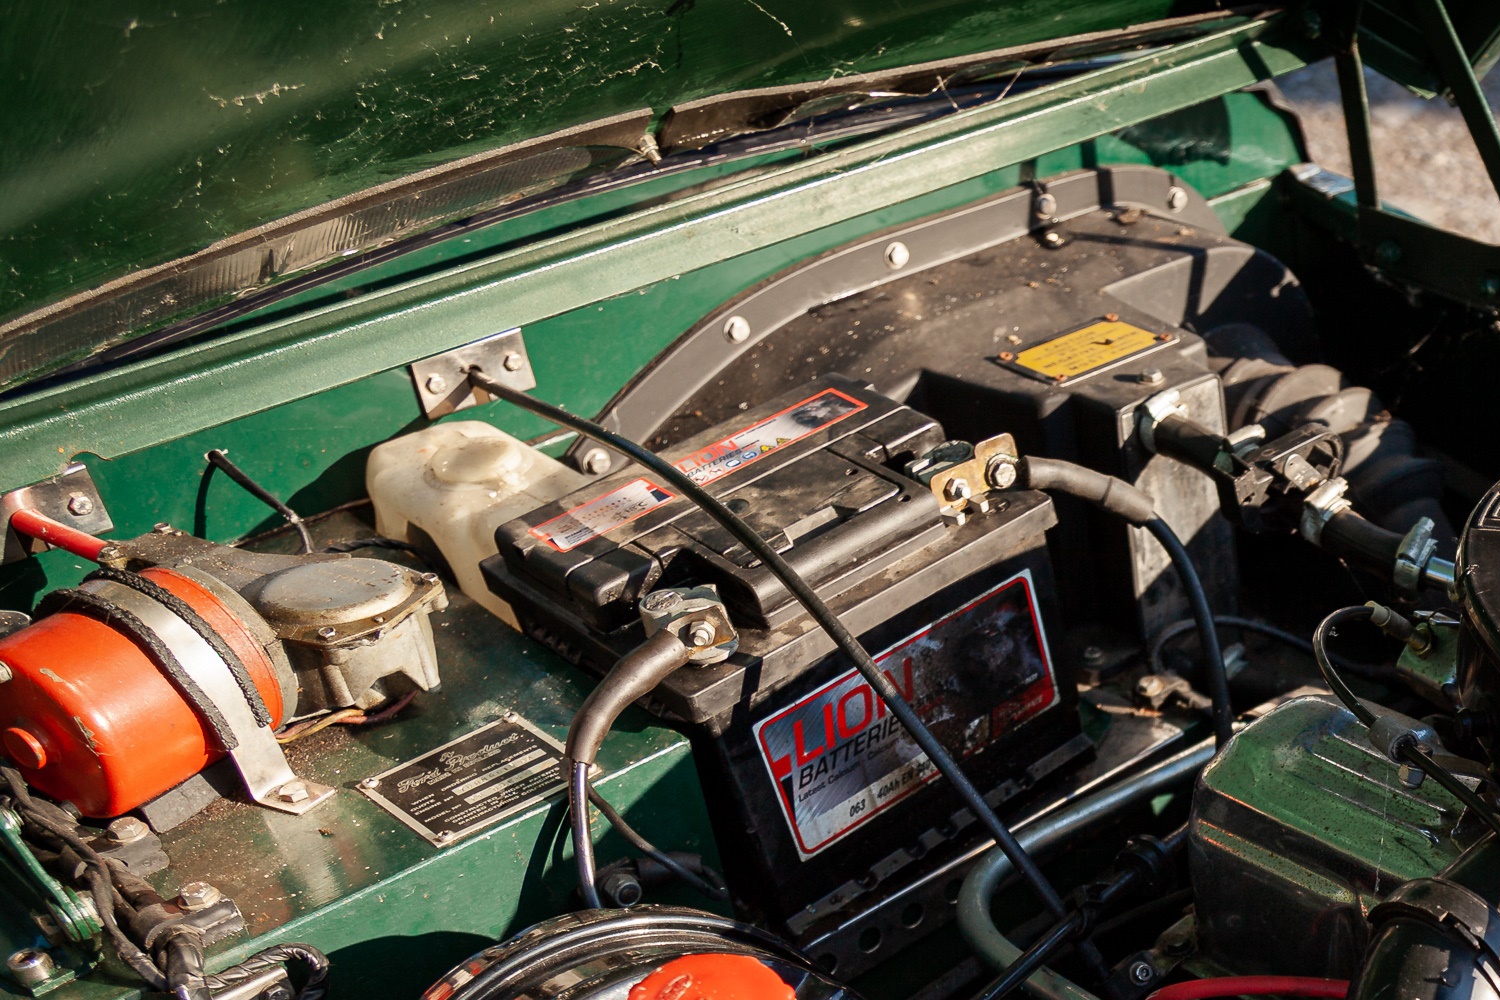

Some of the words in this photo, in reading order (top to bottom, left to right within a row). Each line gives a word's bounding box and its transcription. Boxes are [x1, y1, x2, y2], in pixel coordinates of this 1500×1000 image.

[677, 439, 738, 474] LION
[792, 656, 914, 768] LION
[396, 767, 441, 794] Ford
[444, 732, 520, 772] Product
[798, 714, 902, 790] BATTERIE
[410, 793, 435, 806] WHEN
[440, 772, 478, 792] ORDERING
[482, 744, 538, 772] REPLACEMENTS
[444, 796, 498, 823] CONSTRUCTED
[529, 767, 560, 783] PATENTS
[797, 782, 827, 803] Latest
[410, 798, 436, 813] QUOTE
[414, 801, 442, 816] ENGINE
[424, 809, 451, 823] MODEL
[452, 805, 487, 824] GRANTED
[504, 790, 518, 799] ALL
[522, 772, 560, 791] PRINCIPAL
[849, 798, 867, 818] 063
